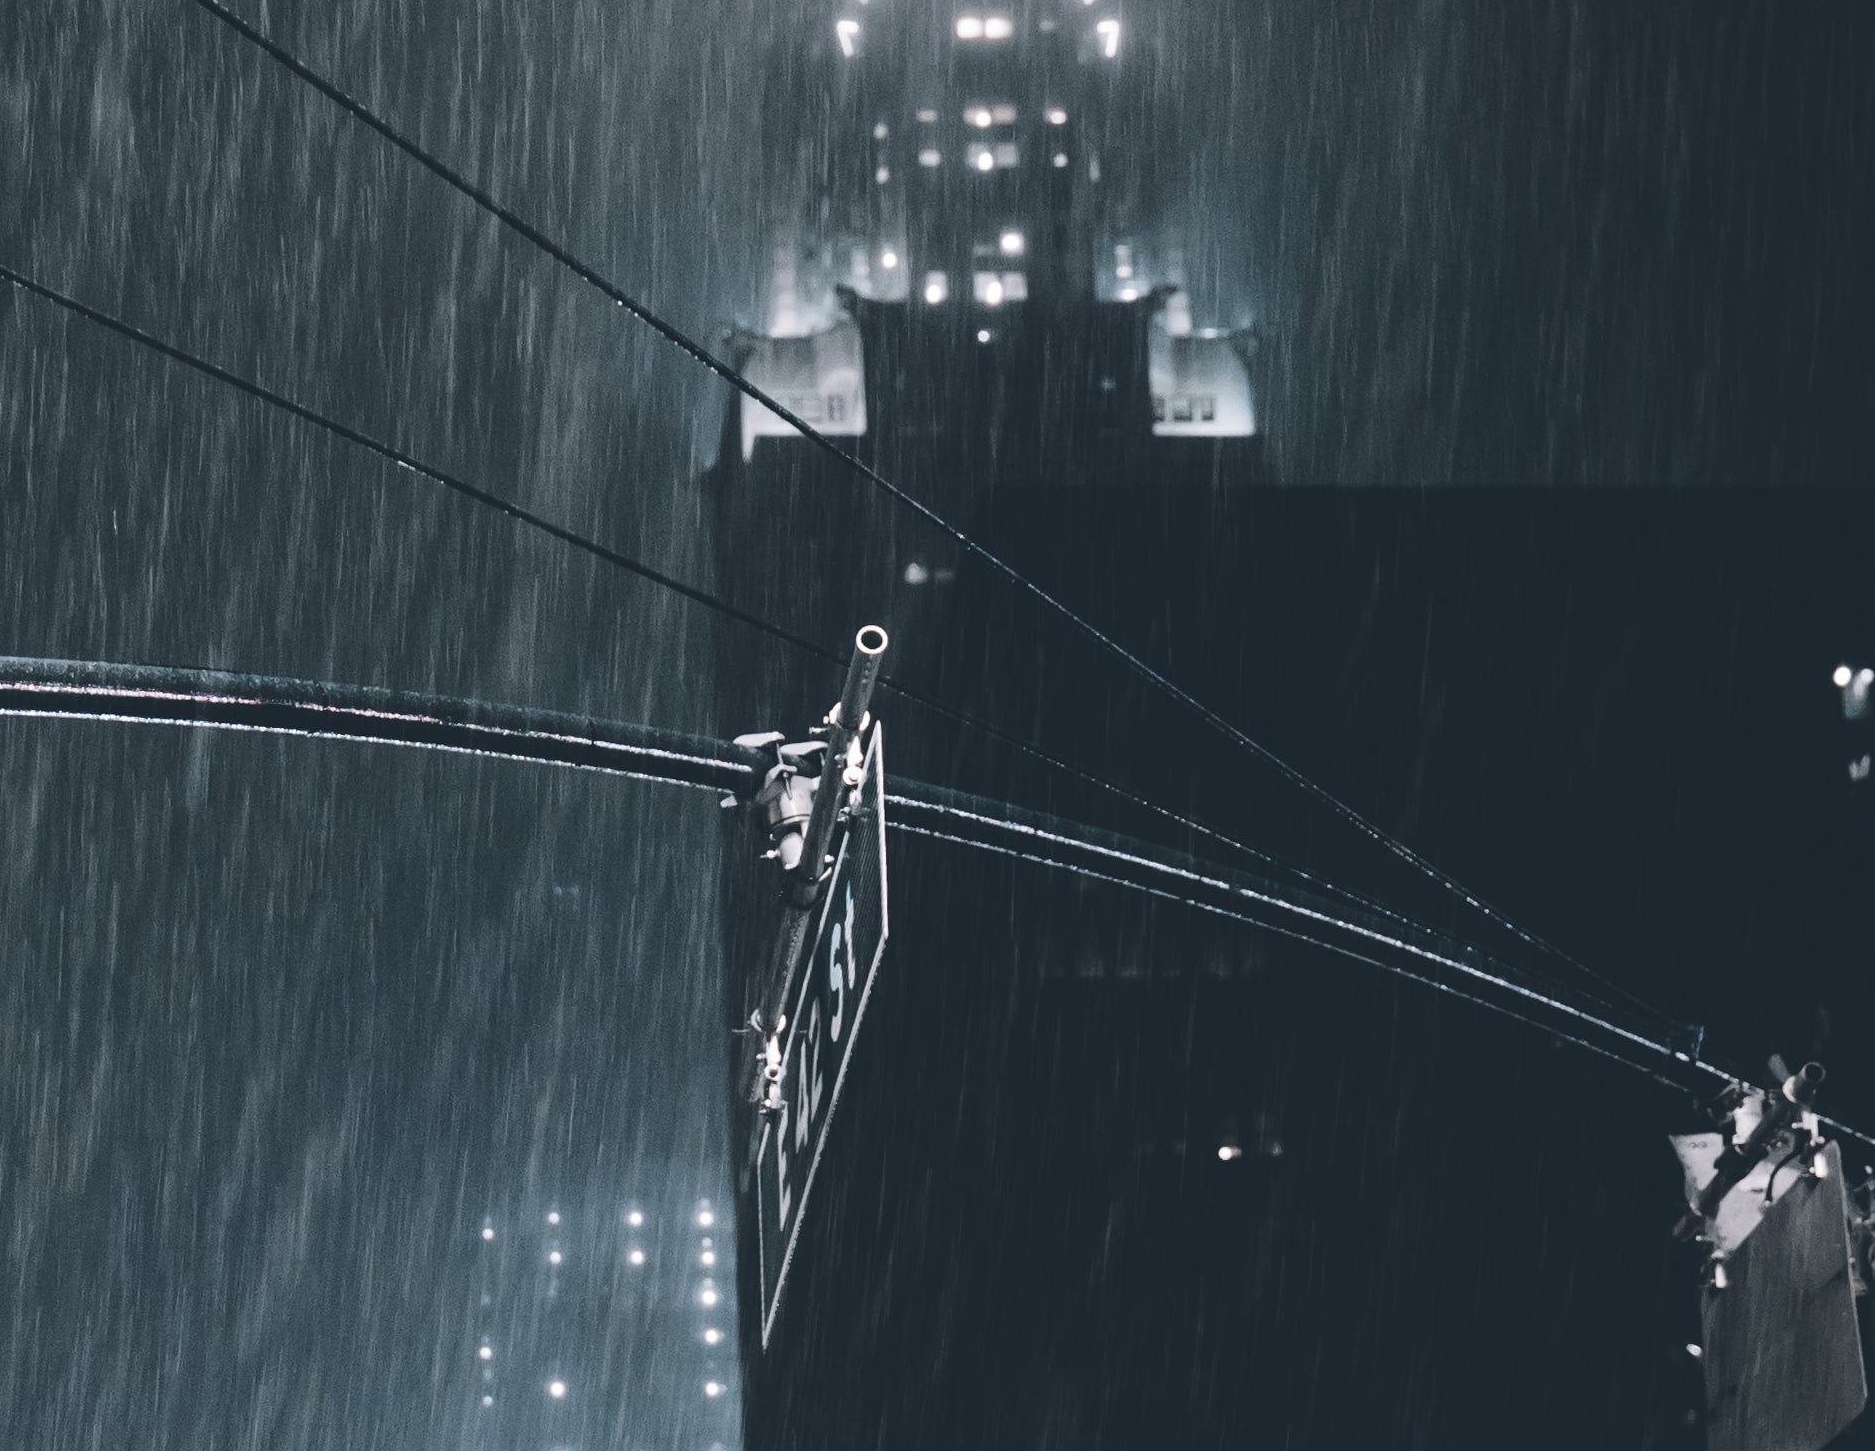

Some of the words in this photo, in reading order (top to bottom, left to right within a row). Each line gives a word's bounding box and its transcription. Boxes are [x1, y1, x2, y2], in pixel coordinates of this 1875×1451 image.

[777, 1104, 791, 1231] E
[797, 999, 822, 1153] 42
[831, 880, 855, 1042] St
